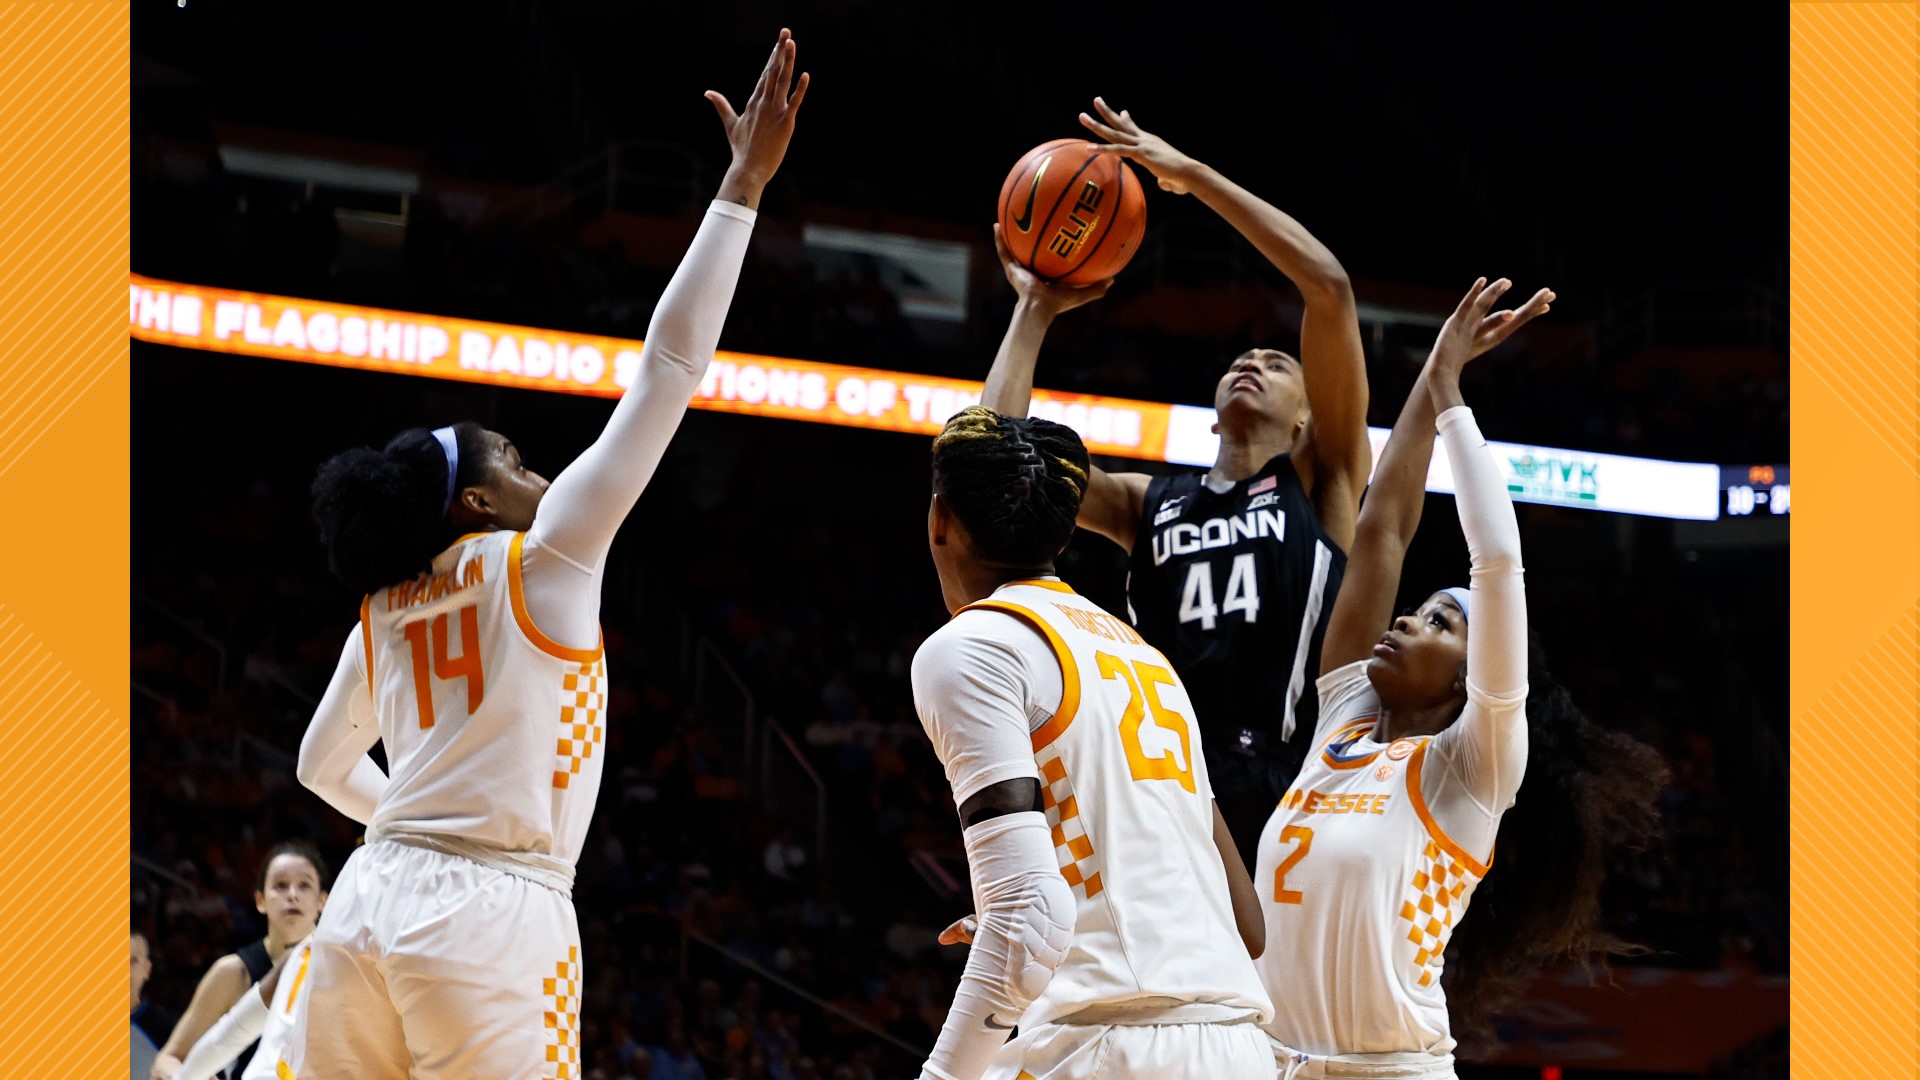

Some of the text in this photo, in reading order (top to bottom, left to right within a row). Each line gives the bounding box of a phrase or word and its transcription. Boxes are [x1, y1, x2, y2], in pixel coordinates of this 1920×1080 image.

[1048, 180, 1105, 259] ELITE
[214, 300, 449, 365] FLAGSHIP
[458, 329, 605, 385] RADIO
[612, 350, 828, 411] STIONS
[835, 375, 897, 418] OF
[902, 384, 1142, 447] TESSEE
[1152, 509, 1286, 567] UCONN
[387, 553, 485, 612] FRANKLIN
[1178, 552, 1261, 632] 44
[1049, 602, 1151, 648] HORSTO
[403, 604, 484, 731] 14
[1094, 650, 1197, 794] 25
[1273, 824, 1315, 905] 2
